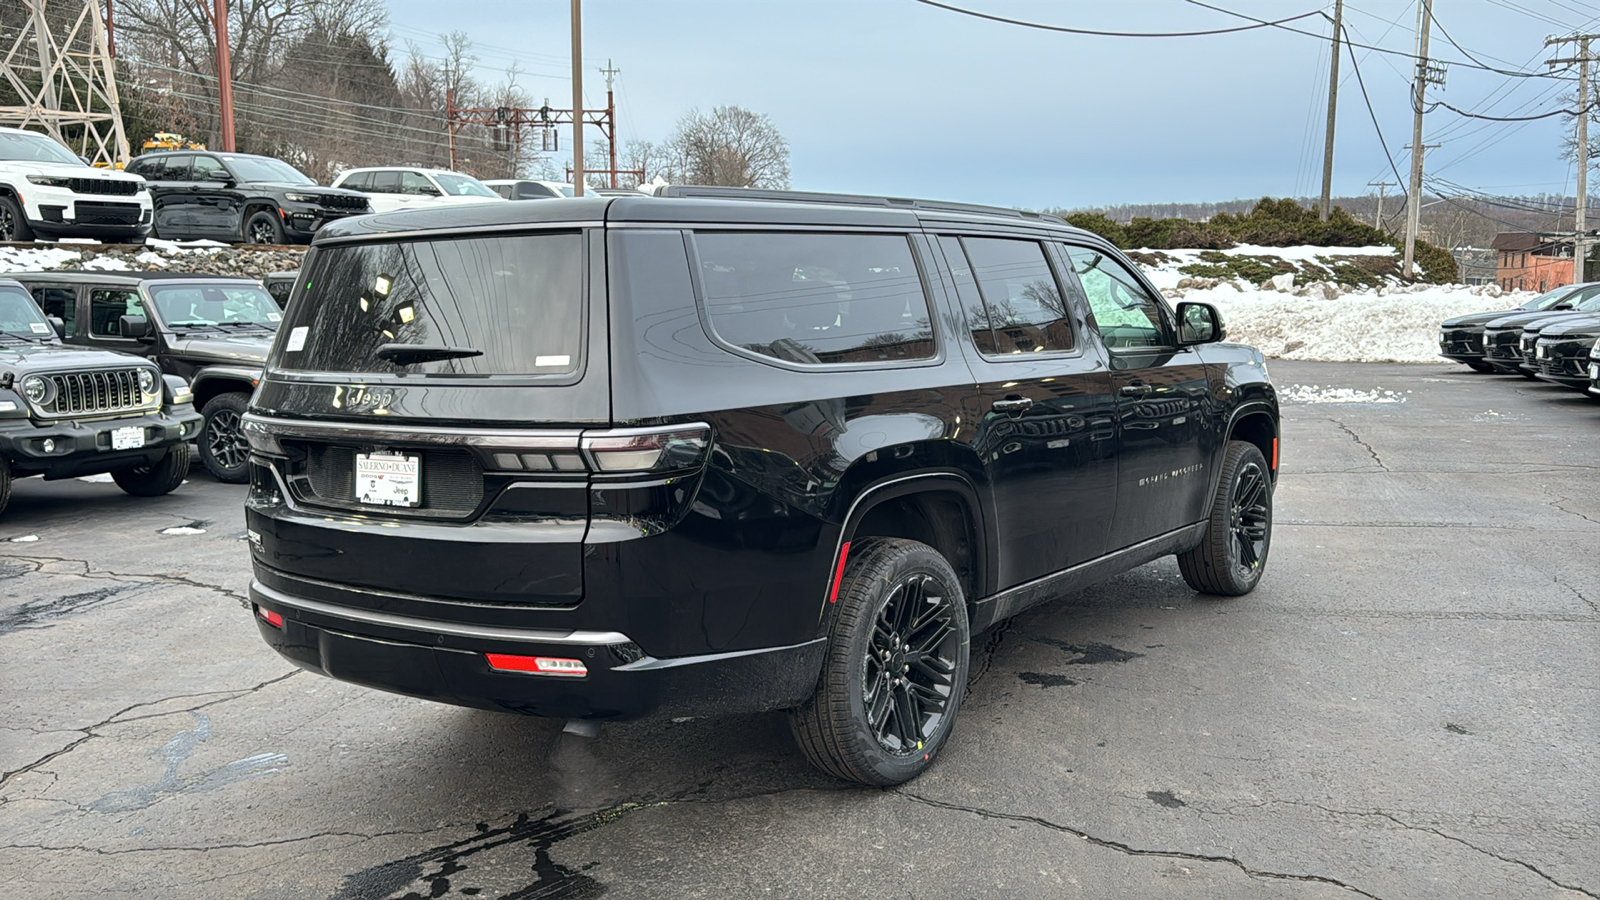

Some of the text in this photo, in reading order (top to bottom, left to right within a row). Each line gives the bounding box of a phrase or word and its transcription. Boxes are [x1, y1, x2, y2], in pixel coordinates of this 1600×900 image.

[350, 388, 392, 409] Jeep
[358, 461, 417, 473] SALERNO DUANE
[393, 486, 409, 495] Jeep
